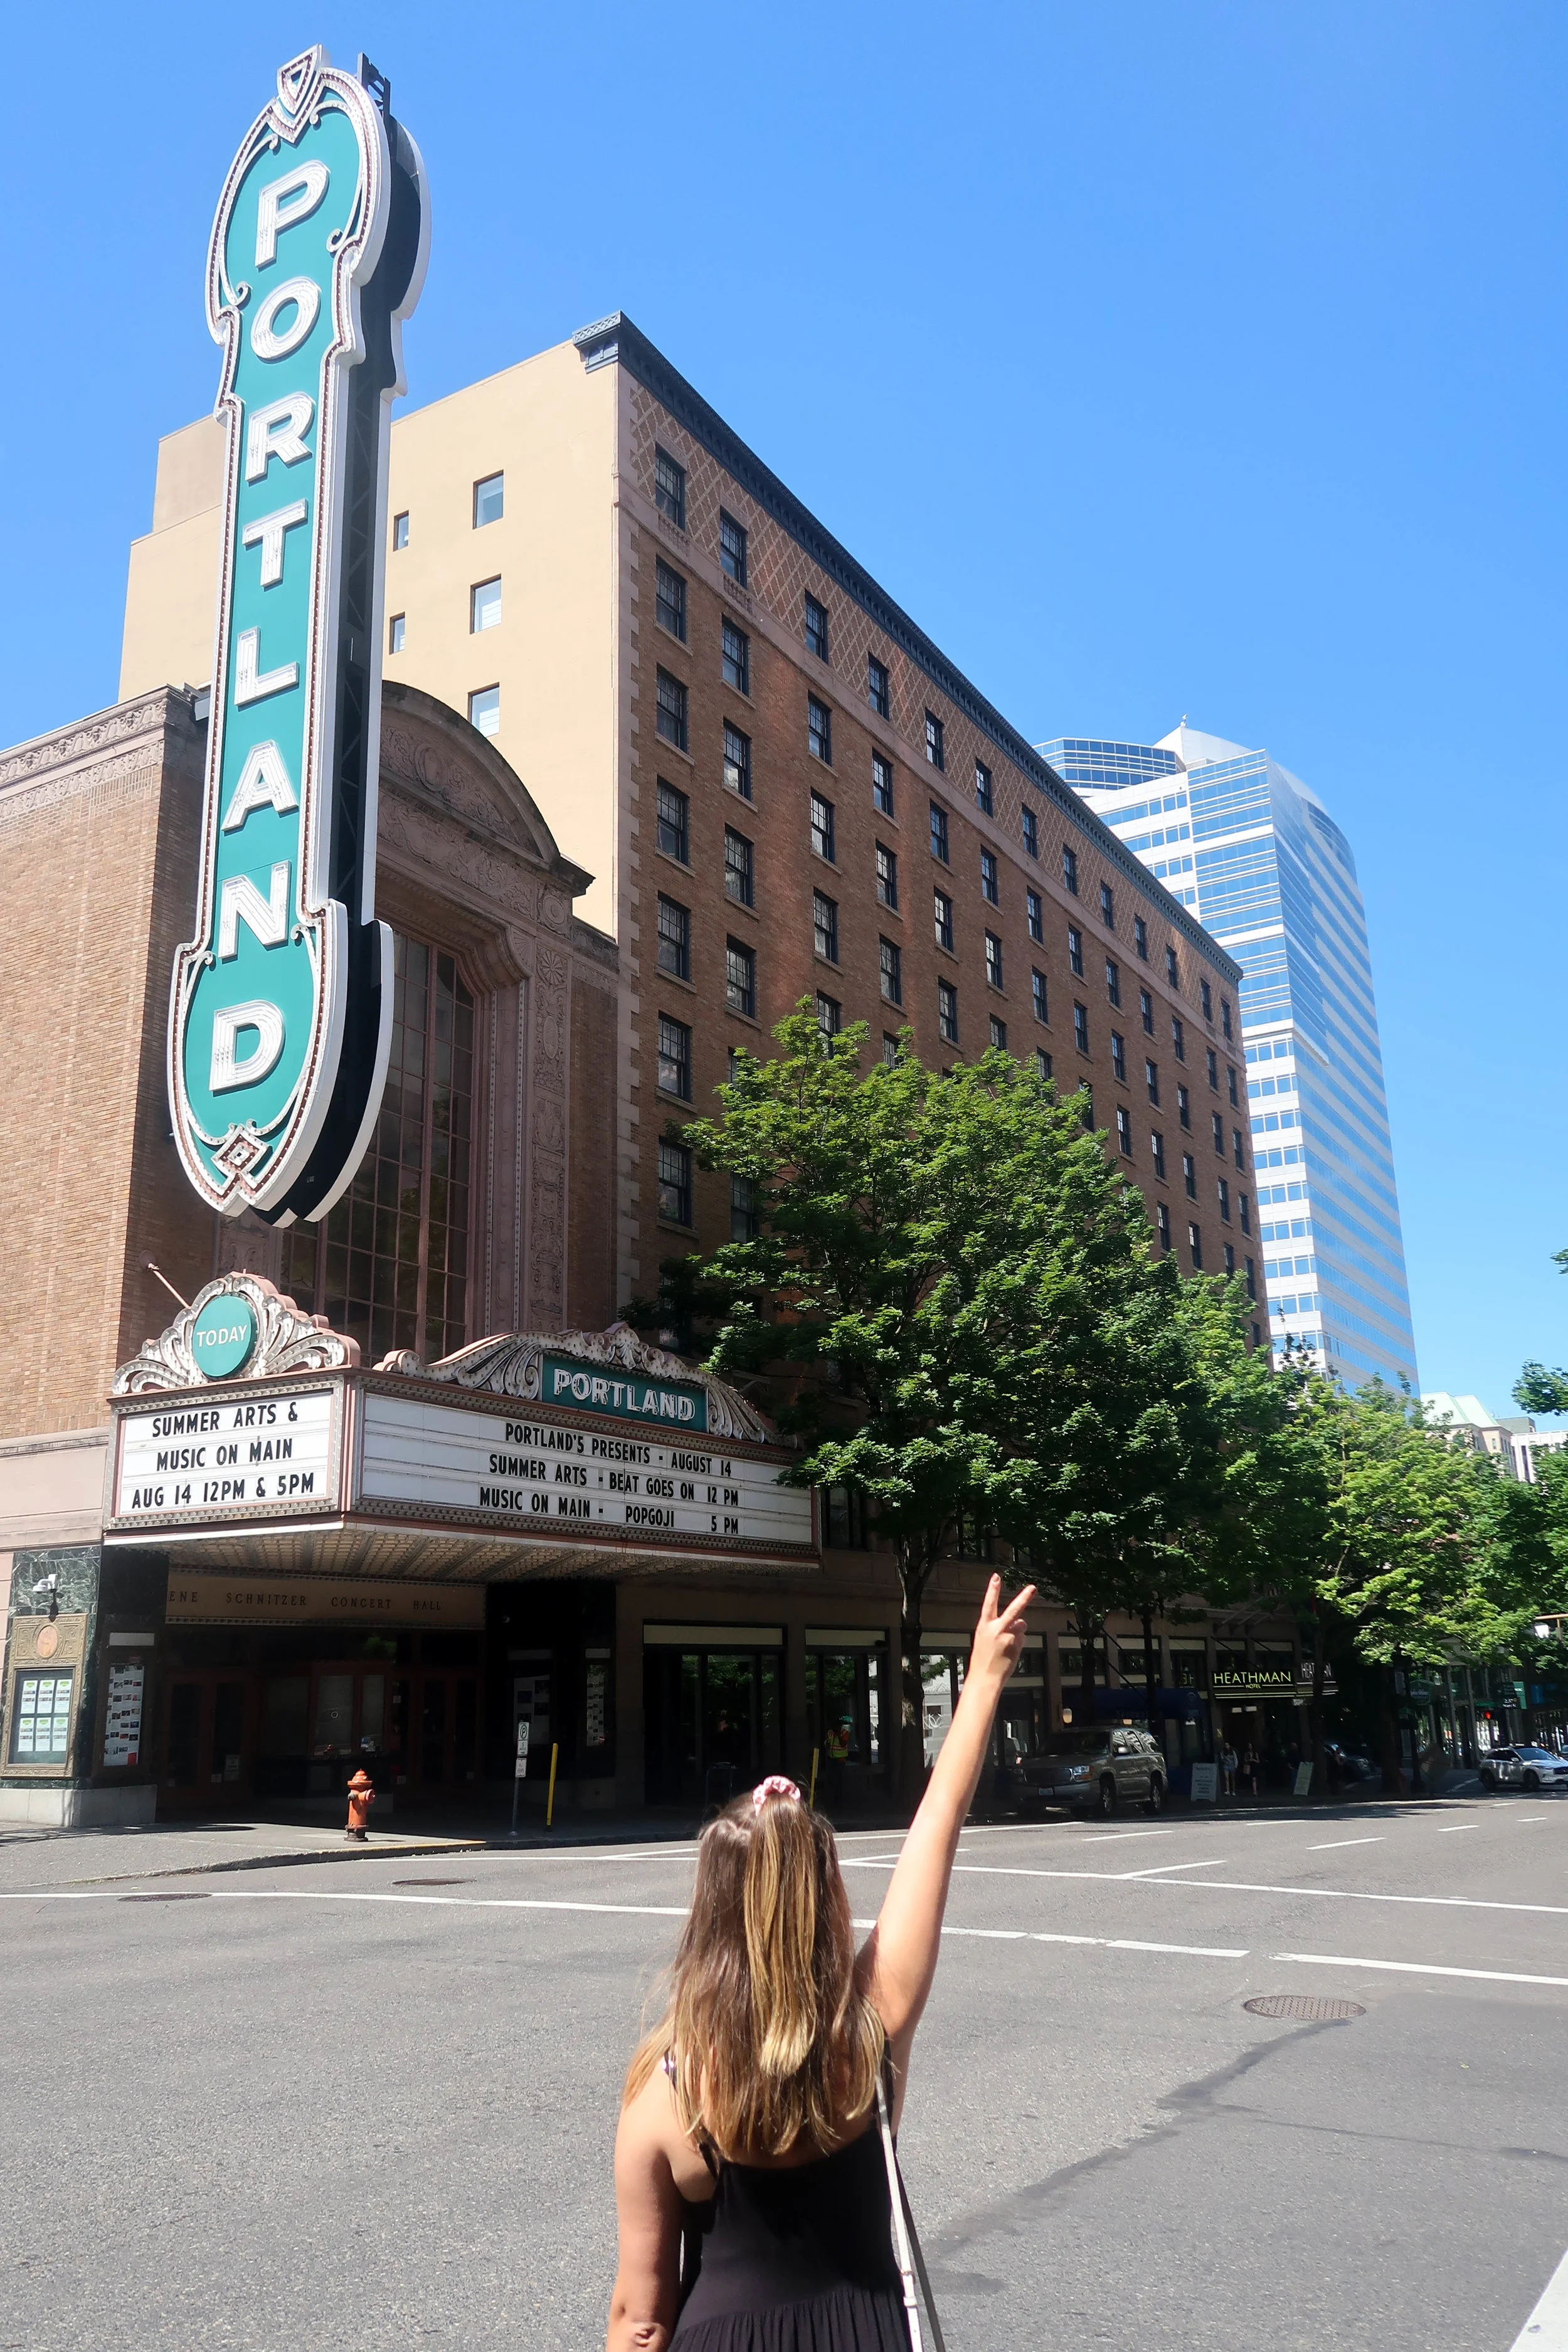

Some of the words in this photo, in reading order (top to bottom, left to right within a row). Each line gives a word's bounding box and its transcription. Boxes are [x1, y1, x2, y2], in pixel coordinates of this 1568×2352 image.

[209, 160, 329, 1093] PORTLAND
[197, 1324, 247, 1347] TODAY
[553, 1368, 695, 1421] PORTLAND
[152, 1411, 220, 1438] SUMMER
[234, 1404, 277, 1428] ARTS
[289, 1402, 298, 1422] &
[157, 1446, 206, 1472] MUSIC
[216, 1444, 238, 1465] ON
[250, 1438, 292, 1462] MAIN
[591, 1438, 650, 1464] PRESENTS
[671, 1450, 712, 1475] AUGUST
[721, 1460, 732, 1477] 14
[132, 1486, 164, 1509] AUG
[175, 1483, 191, 1505] 14
[203, 1481, 245, 1503] 12PM
[256, 1478, 266, 1497] &
[277, 1473, 314, 1496] 5PM
[489, 1454, 546, 1480] SUMMER
[555, 1465, 587, 1486] ARTS
[609, 1471, 638, 1493] BEAT
[646, 1478, 674, 1498] GOES
[681, 1483, 694, 1500] ON
[707, 1486, 717, 1503] 12
[724, 1489, 738, 1506] PM
[479, 1486, 522, 1511] MUSIC
[532, 1493, 548, 1513] ON
[559, 1497, 590, 1518] MAIN
[626, 1505, 675, 1527] POPGOJI
[711, 1515, 717, 1532] 5
[724, 1517, 738, 1534] PM
[226, 1592, 307, 1606] SCHNITZER
[331, 1597, 392, 1610] CONCERT
[413, 1600, 442, 1611] HALL
[1214, 1671, 1291, 1684] HEATHMAN
